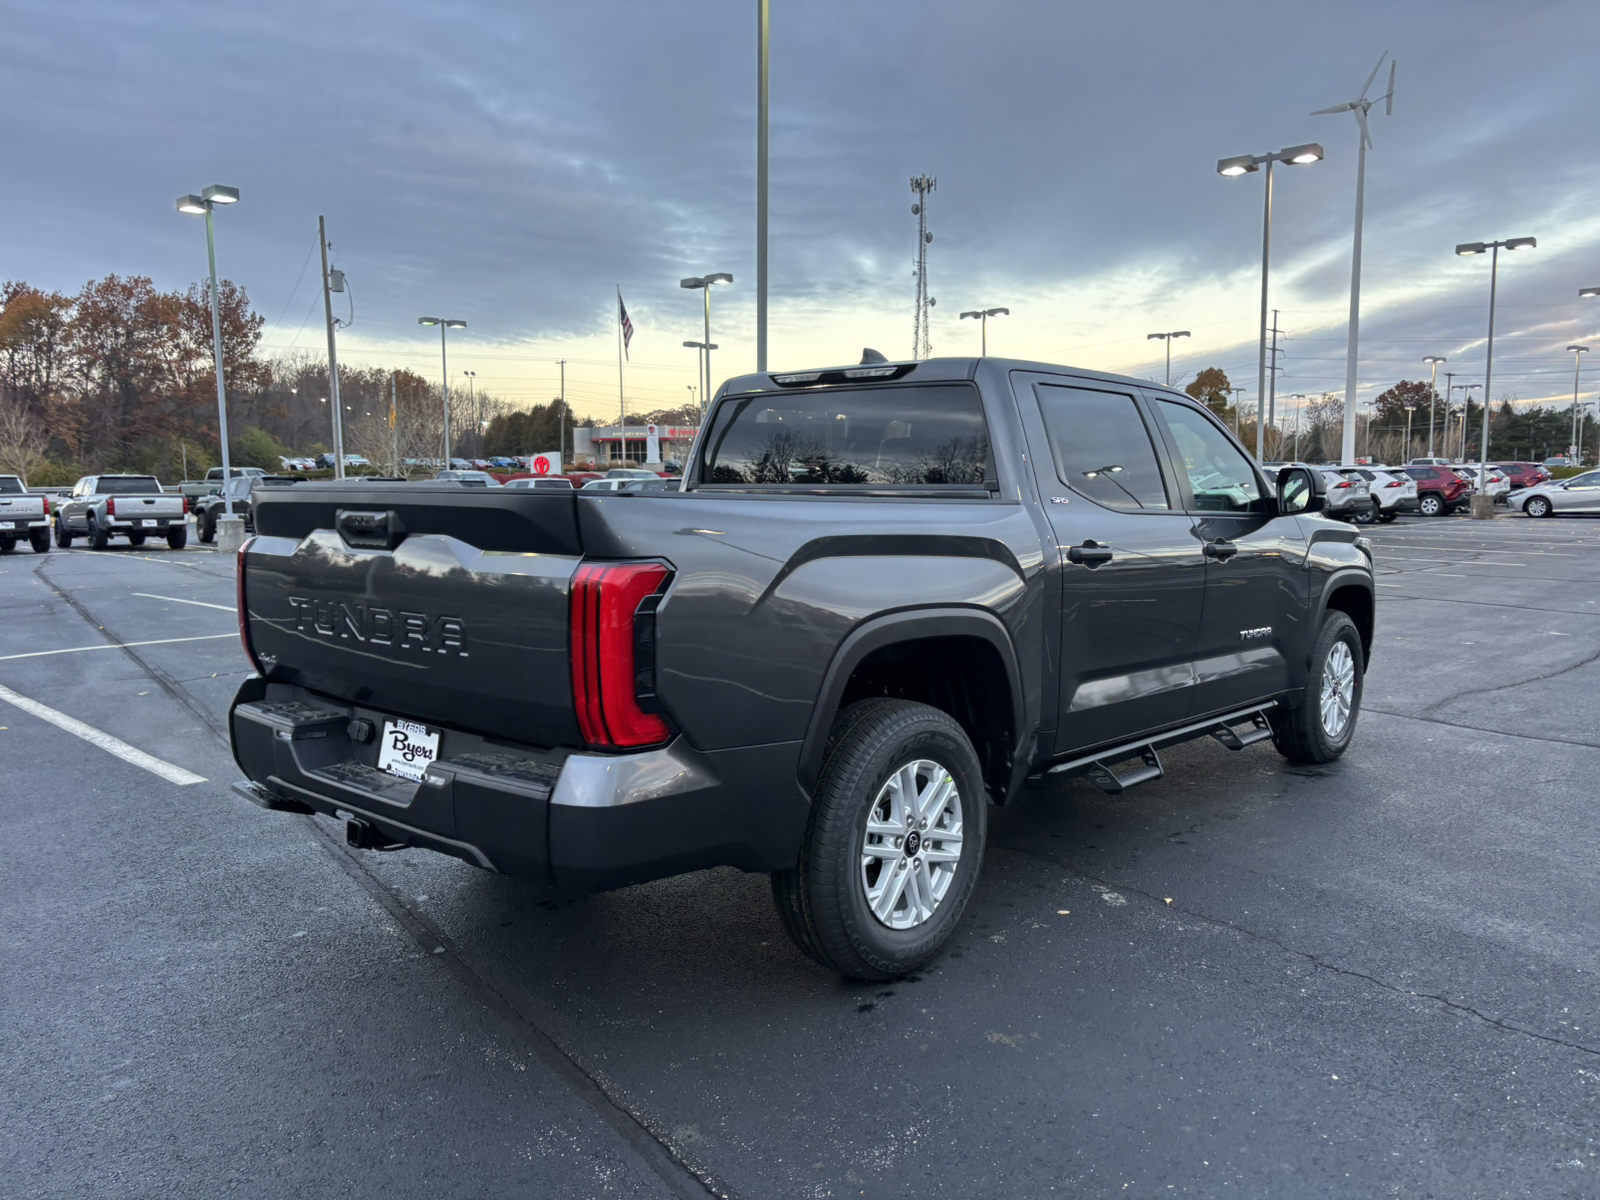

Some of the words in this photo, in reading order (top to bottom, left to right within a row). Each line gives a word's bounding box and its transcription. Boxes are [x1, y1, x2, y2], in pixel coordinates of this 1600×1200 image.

[288, 596, 470, 657] TUNDRA
[1239, 627, 1272, 640] TUNDRA
[397, 720, 426, 735] BYERS
[388, 730, 433, 762] Byers
